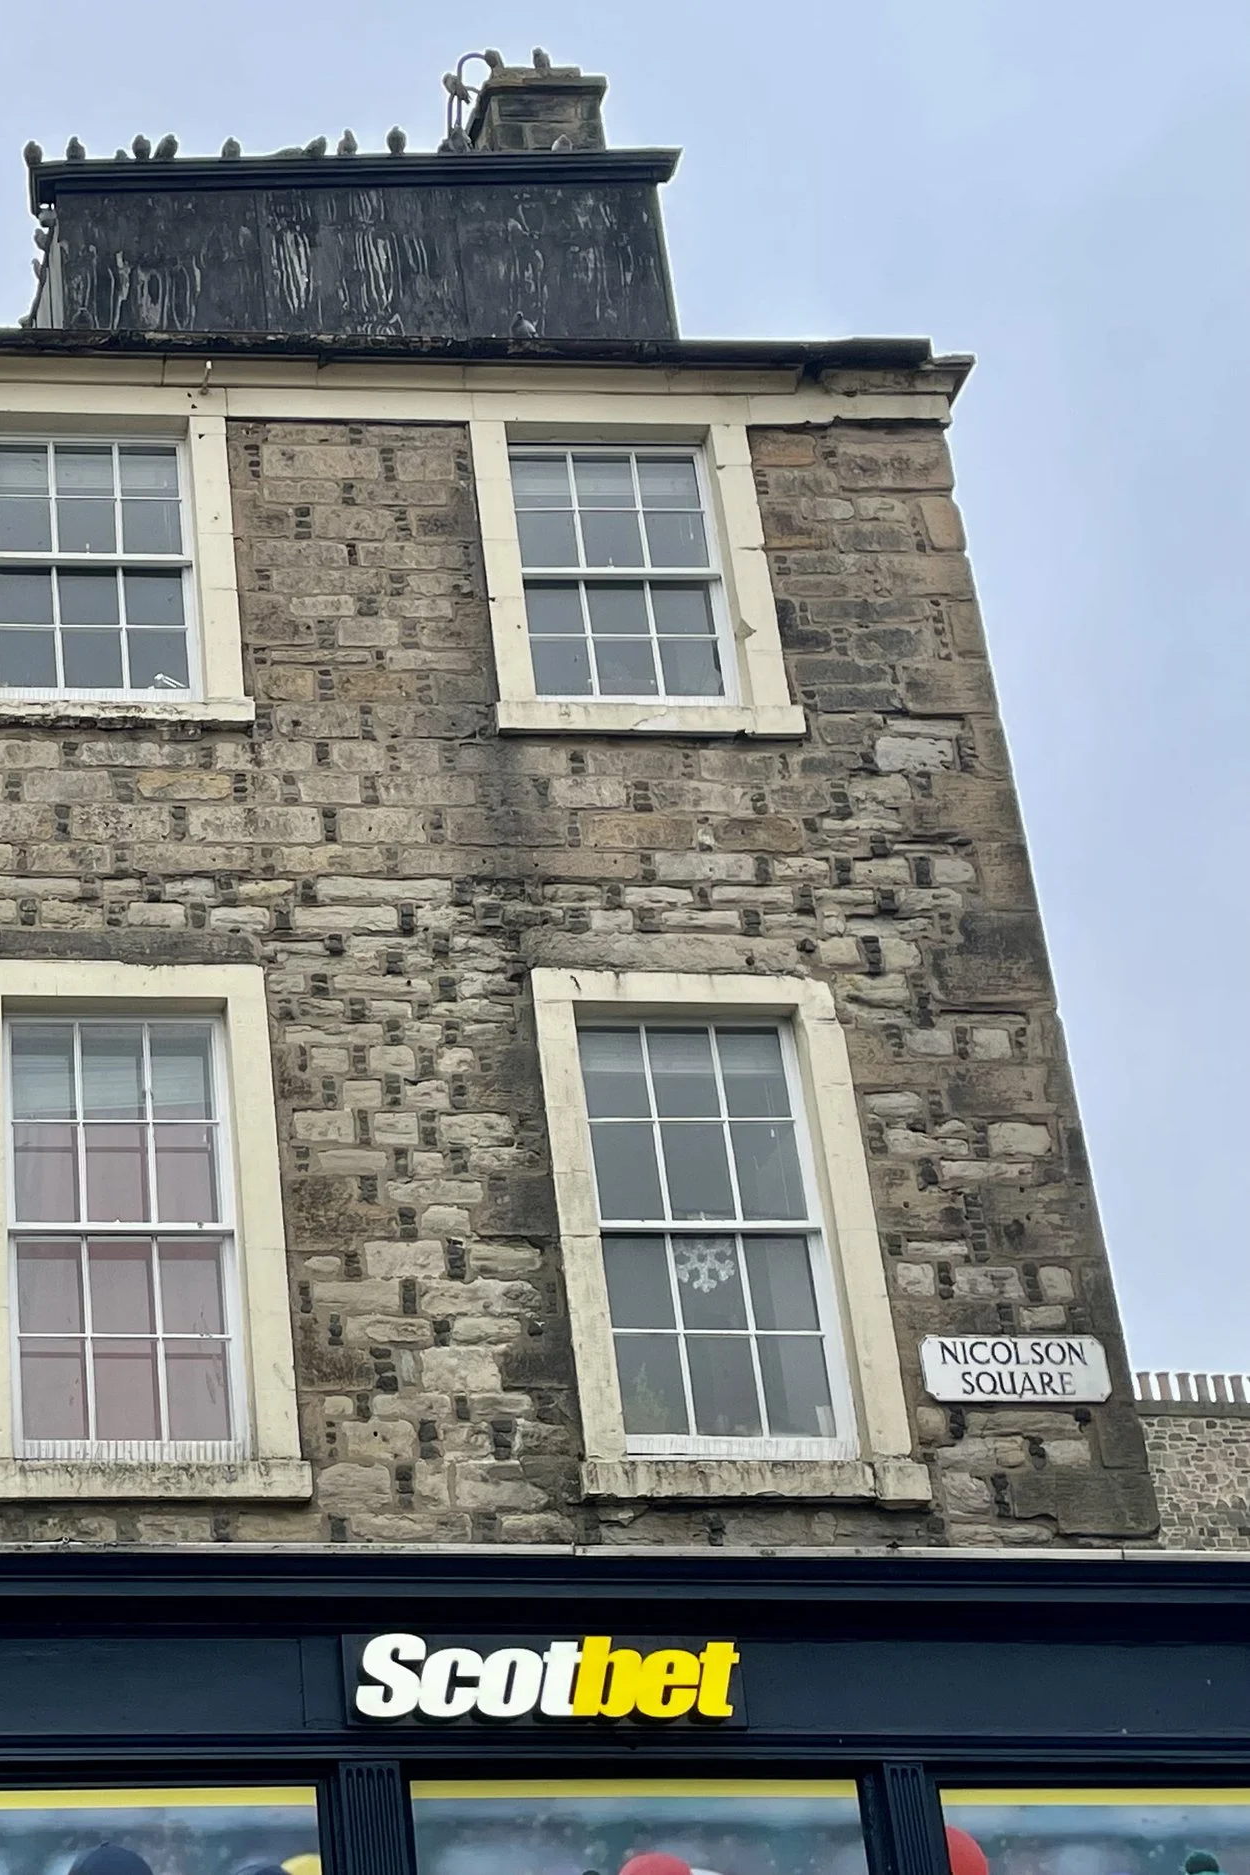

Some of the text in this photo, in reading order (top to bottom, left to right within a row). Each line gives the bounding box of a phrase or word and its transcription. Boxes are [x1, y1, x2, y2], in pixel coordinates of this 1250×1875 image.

[937, 1340, 1089, 1366] NICOLSON
[961, 1370, 1077, 1398] SQUARE
[355, 1632, 741, 1719] Scotbet
